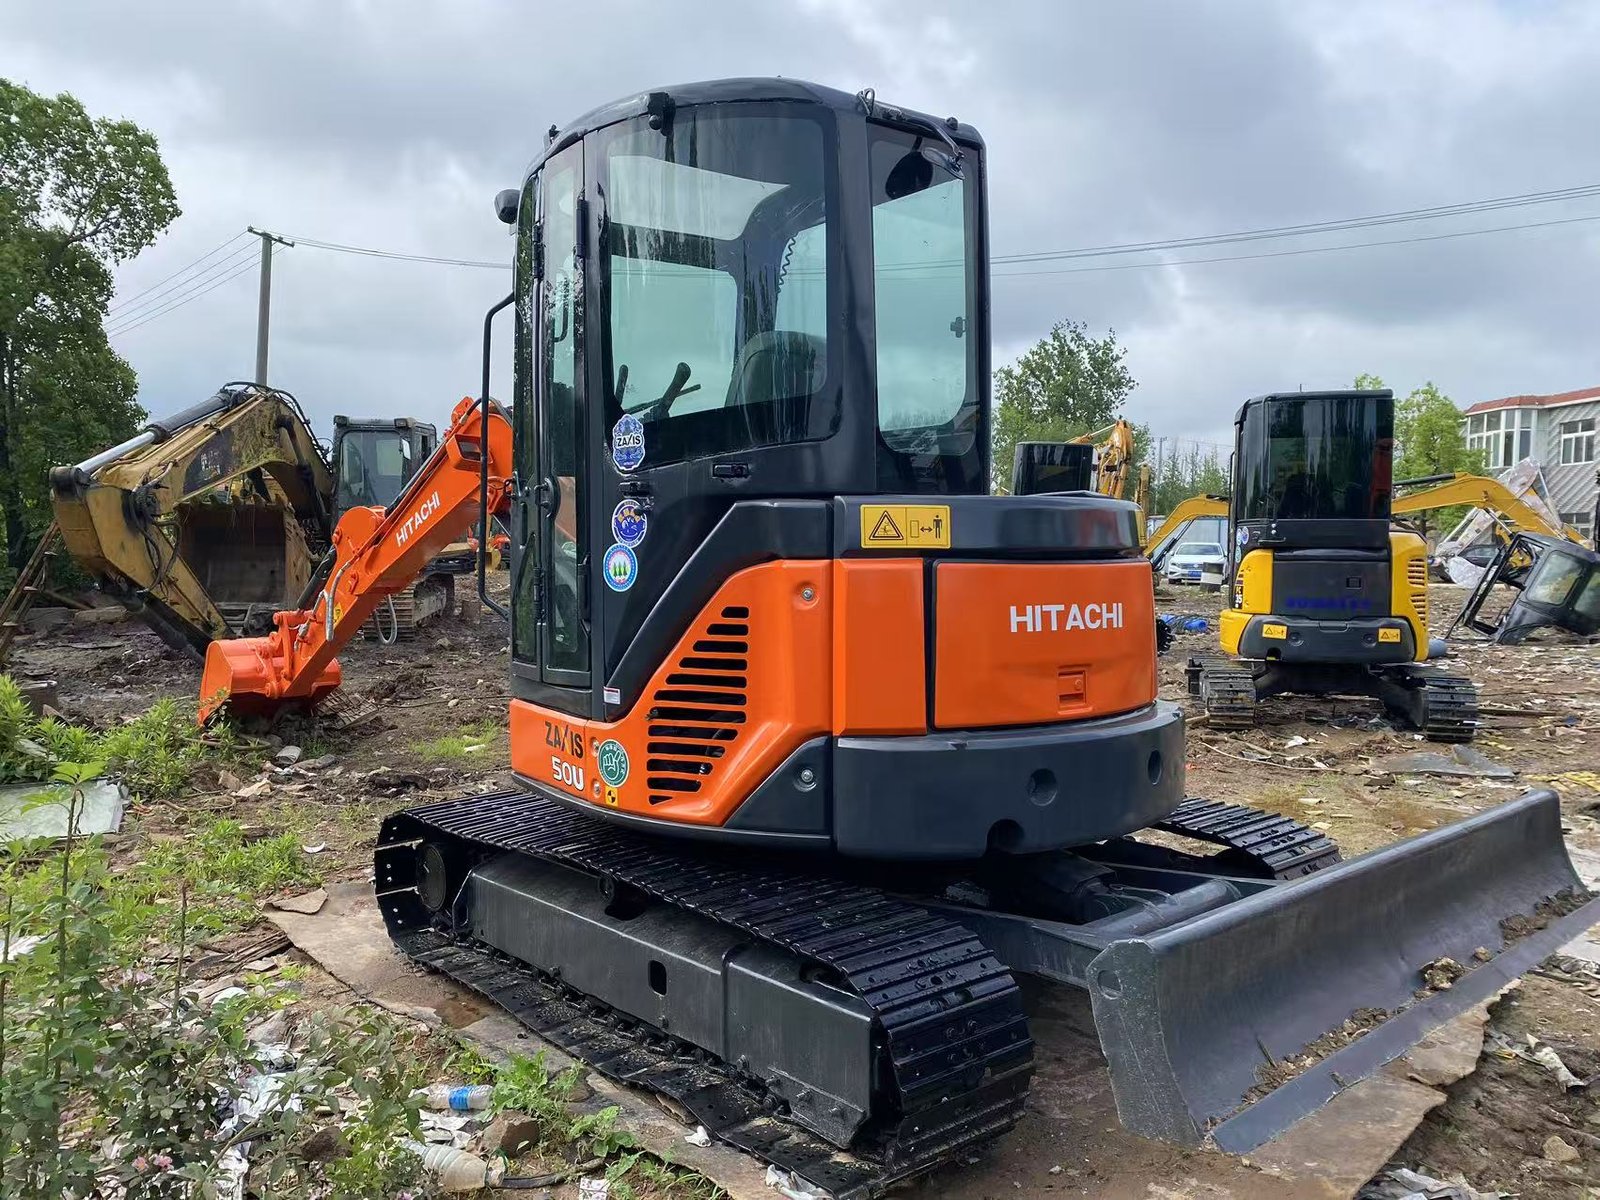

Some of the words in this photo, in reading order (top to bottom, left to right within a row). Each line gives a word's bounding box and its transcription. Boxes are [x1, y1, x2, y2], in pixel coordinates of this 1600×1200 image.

[617, 434, 641, 447] ZAXIS
[395, 491, 440, 547] HITACHI
[1009, 602, 1123, 633] HITACHI
[545, 721, 583, 759] ZAXIS
[551, 755, 584, 791] 50U
